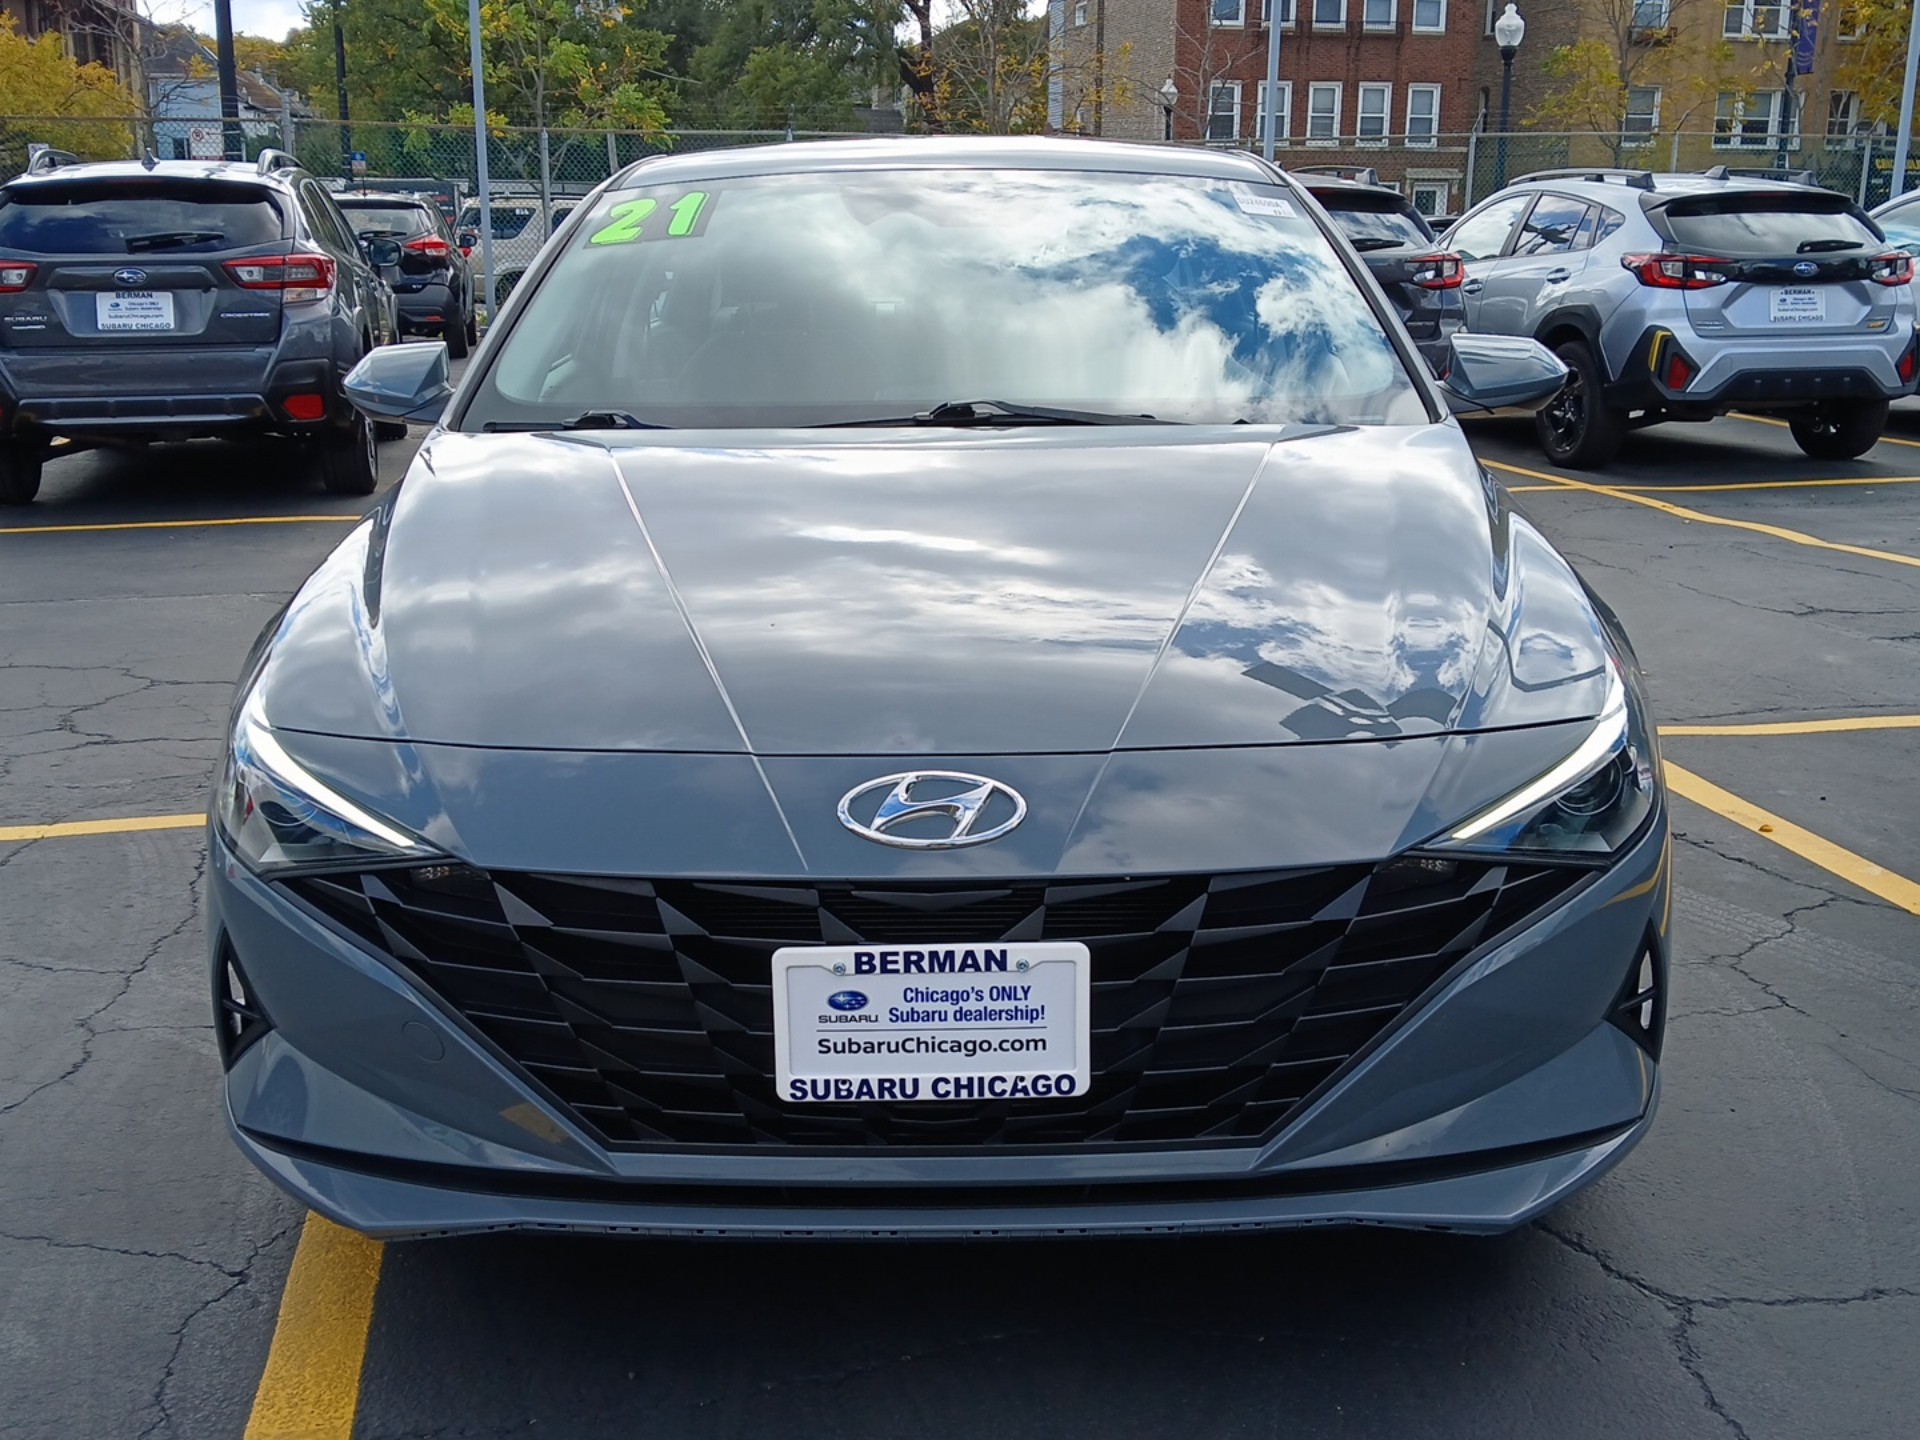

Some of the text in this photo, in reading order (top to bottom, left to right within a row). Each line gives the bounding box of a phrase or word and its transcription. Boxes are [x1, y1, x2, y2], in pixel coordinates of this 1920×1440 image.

[115, 291, 153, 299] BERMAN
[854, 949, 1008, 975] BERMAN
[903, 986, 1031, 1006] Chicago's ONLY
[818, 1014, 879, 1024] SUBARU
[888, 1005, 1046, 1025] Subaru dealership!
[817, 1036, 1047, 1057] SubaruChicago.com
[789, 1074, 1077, 1101] SUBARU CHICAGO
